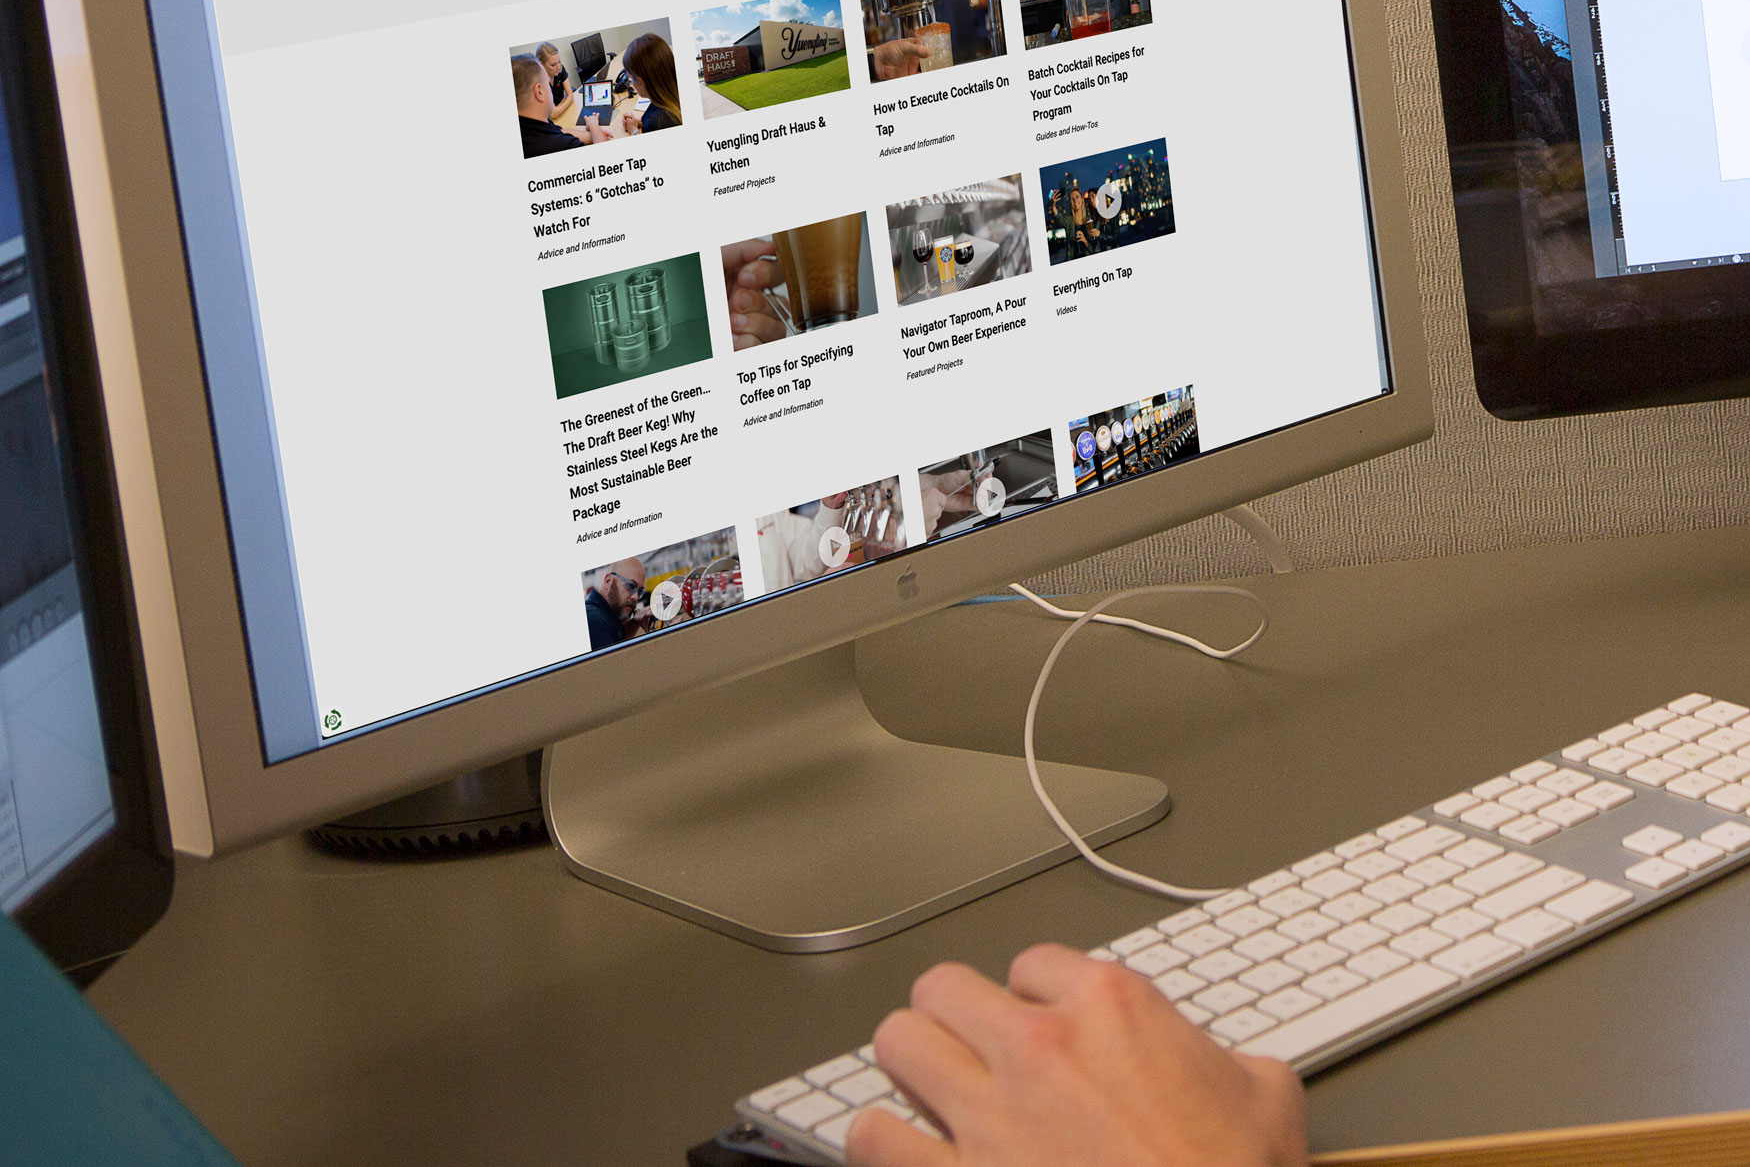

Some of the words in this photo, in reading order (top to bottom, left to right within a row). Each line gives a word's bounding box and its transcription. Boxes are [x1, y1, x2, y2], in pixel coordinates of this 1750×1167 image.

[706, 50, 734, 63] DRAFT
[781, 27, 828, 60] Yuengling
[707, 60, 731, 72] HAUS
[1028, 65, 1055, 80] Batch
[1056, 56, 1093, 74] Cocktail
[1094, 50, 1130, 66] Recipes
[1131, 46, 1144, 57] for
[873, 102, 895, 115] How
[897, 99, 908, 110] to
[910, 90, 948, 107] Execute
[950, 79, 994, 98] Cocktails
[995, 76, 1009, 87] On
[1029, 88, 1051, 100] Your
[1053, 76, 1095, 95] Cocktails
[1097, 74, 1110, 85] On
[1111, 71, 1128, 83] Tap
[1032, 104, 1072, 121] Program
[706, 133, 759, 152] Yuengling
[761, 124, 787, 140] Draft
[789, 120, 816, 134] Haus
[818, 116, 826, 127] &
[875, 124, 894, 136] Tap
[527, 166, 595, 192] Commercial
[598, 163, 623, 177] Beer
[625, 158, 646, 171] Tap
[709, 157, 750, 174] Kitchen
[530, 195, 583, 217] Systems:
[585, 190, 593, 202] 6
[652, 176, 664, 187] to
[713, 180, 745, 196] Featured
[746, 175, 775, 188] Projects
[533, 219, 569, 237] Watch
[572, 216, 590, 229] For
[537, 248, 564, 260] Advice
[565, 242, 580, 254] and
[581, 233, 625, 250] Information
[1053, 276, 1100, 296] Everything
[1101, 271, 1114, 282] On
[1115, 267, 1132, 278] Tap
[900, 318, 947, 339] Navigator
[948, 306, 993, 325] Taproom,
[995, 301, 1003, 313] A
[1004, 296, 1026, 310] Pour
[1056, 305, 1077, 316] Videos
[902, 345, 925, 359] Your
[927, 339, 949, 352] Own
[951, 332, 973, 346] Beer
[975, 318, 1026, 339] Experience
[736, 371, 756, 384] Top
[758, 364, 781, 378] Tips
[783, 359, 798, 371] for
[800, 344, 853, 368] Specifying
[740, 388, 774, 405] Coffee
[777, 384, 790, 395] on
[791, 378, 811, 390] Tap
[559, 419, 582, 432] The
[584, 403, 635, 426] Greenest
[637, 397, 648, 412] of
[650, 395, 668, 408] the
[563, 441, 585, 455] The
[587, 430, 615, 448] Draft
[617, 425, 643, 440] Beer
[645, 415, 669, 432] Keg!
[671, 409, 695, 424] Why
[566, 455, 617, 477] Stainless
[620, 443, 648, 461] Steel
[650, 438, 677, 453] Kegs
[680, 432, 698, 445] Are
[700, 426, 718, 439] the
[569, 481, 599, 499] Most
[600, 462, 664, 490] Sustainable
[666, 455, 691, 471] Beer
[572, 499, 620, 521] Package
